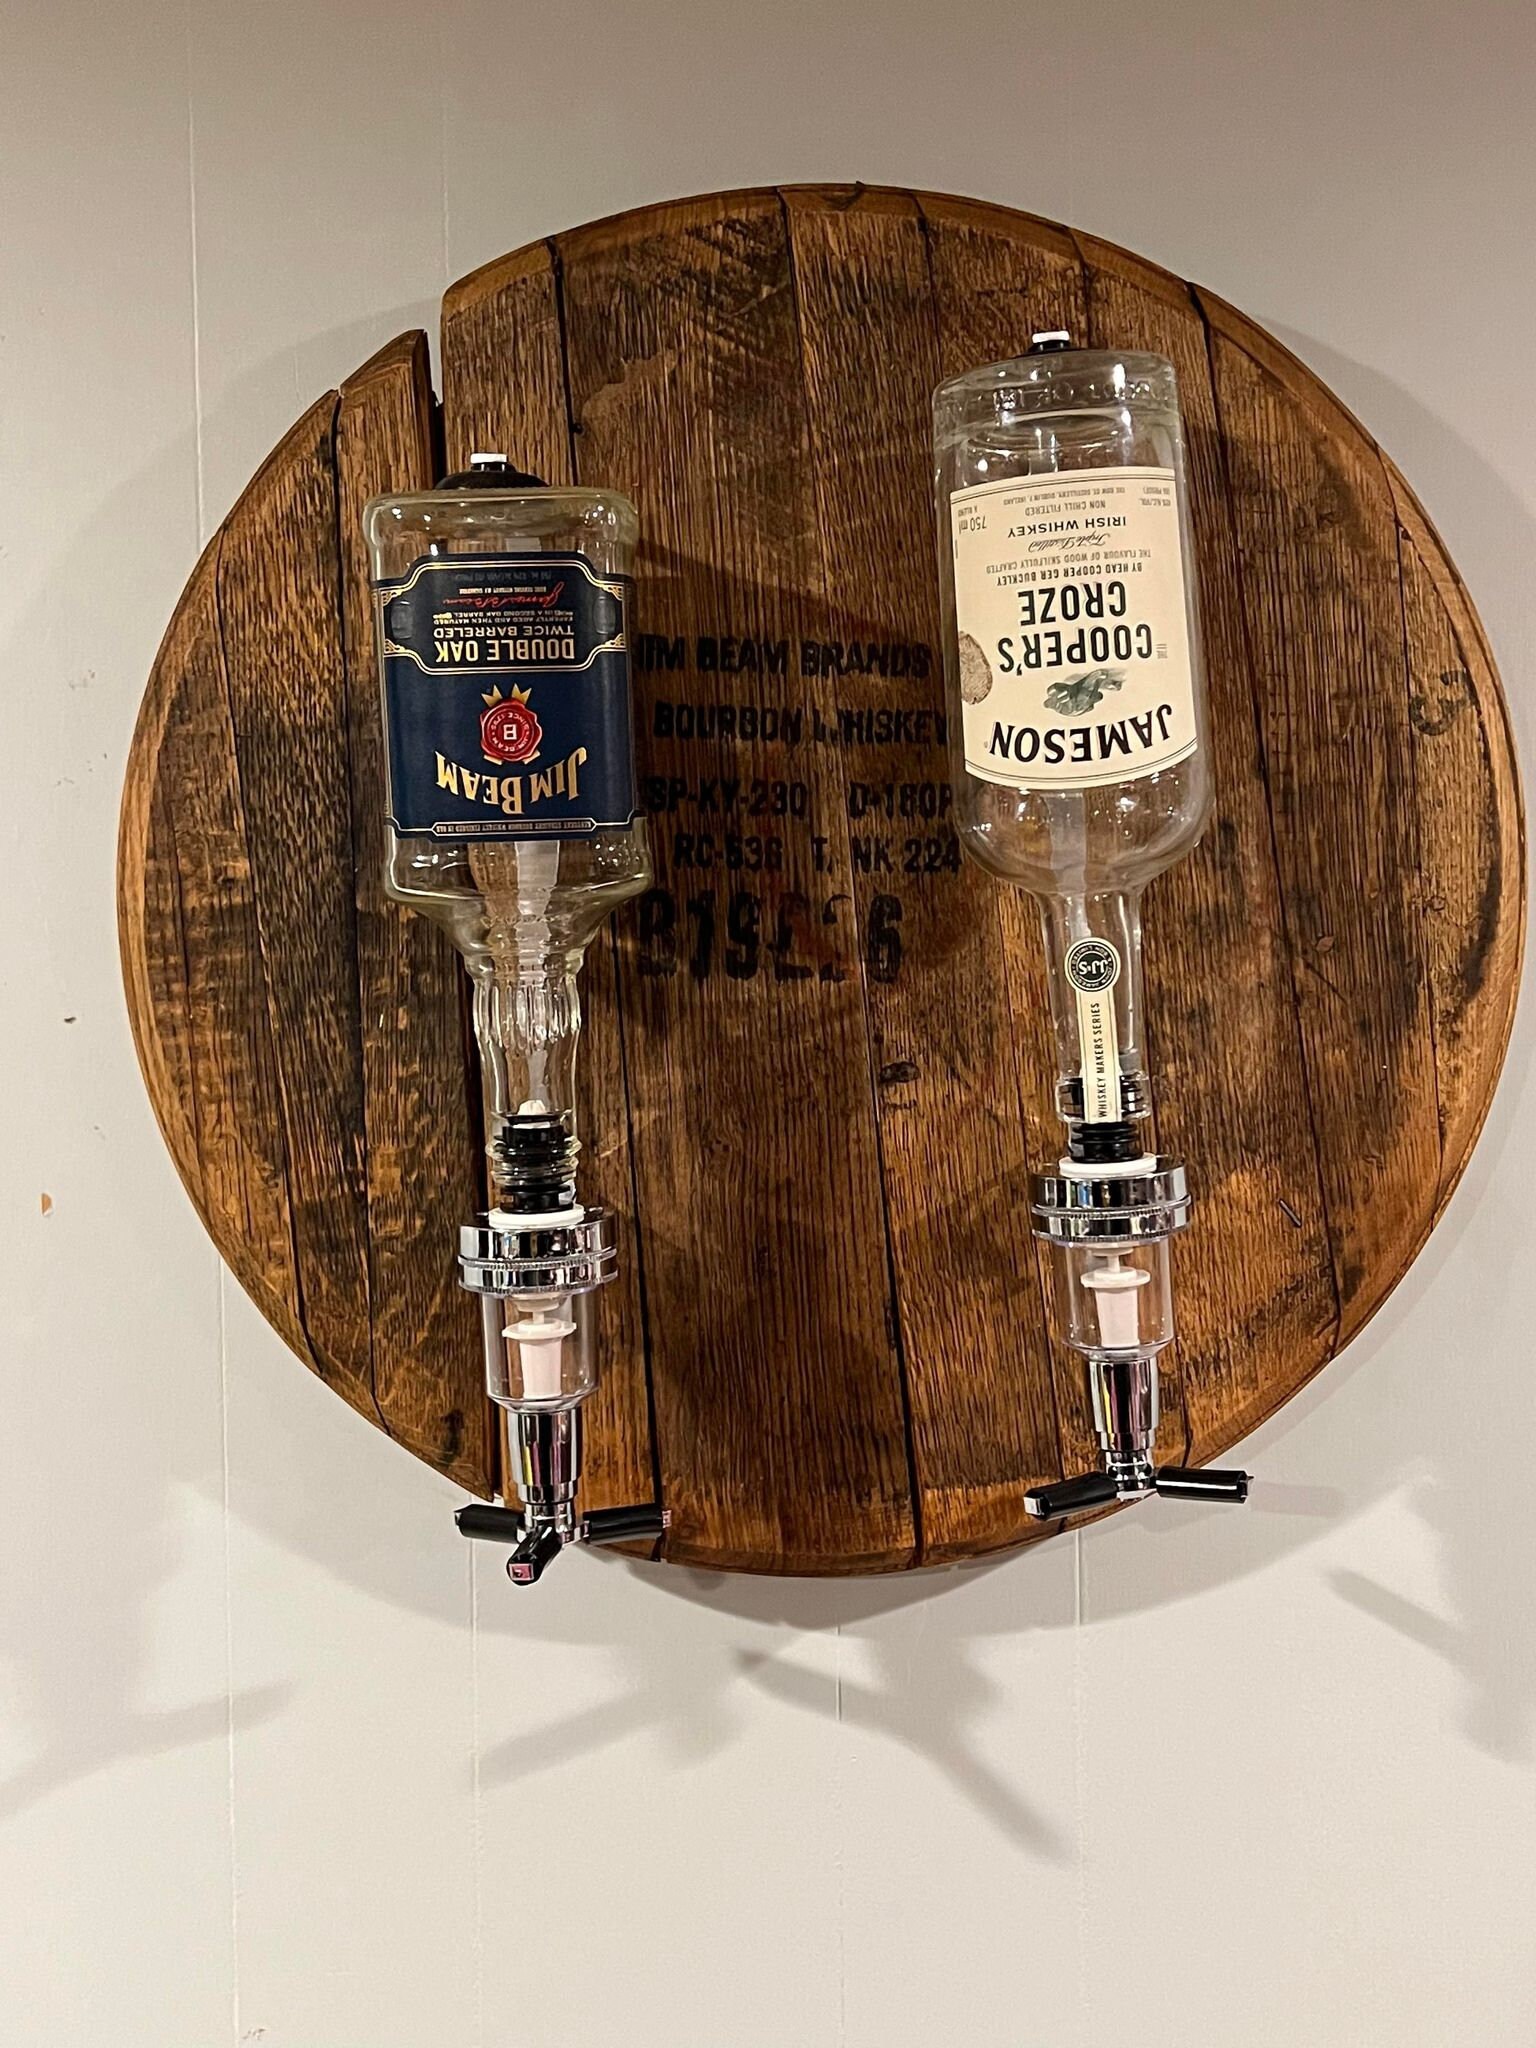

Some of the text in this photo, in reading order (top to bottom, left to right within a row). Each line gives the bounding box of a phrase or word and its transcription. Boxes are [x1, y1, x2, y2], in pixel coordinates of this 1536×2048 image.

[1024, 500, 1106, 516] NON CHILL FILTERED
[958, 514, 987, 532] 750 ml
[1006, 516, 1126, 538] IRISH WHISKEY
[1027, 530, 1111, 553] Triple Distilled
[986, 548, 1151, 575] THE FLAVOUR OF WOOD SKILFULLY CRAFTED
[996, 562, 1142, 586] BY HEAD COOPER GER BUCKLEY
[1017, 580, 1127, 626] CROZE
[433, 625, 574, 638] TWICE BARRELED
[434, 638, 575, 662] DOUBLE OAK
[698, 636, 789, 674] BEAM
[800, 640, 931, 679] BRANDS
[997, 623, 1152, 676] COOPER'S
[503, 724, 517, 740] B
[653, 701, 801, 745] BOURBON
[989, 704, 1172, 764] JAMESON
[434, 747, 587, 815] JIM BEAM
[810, 837, 894, 874] TNK
[1091, 1002, 1108, 1118] WHISKEY MAKERS SERIES
